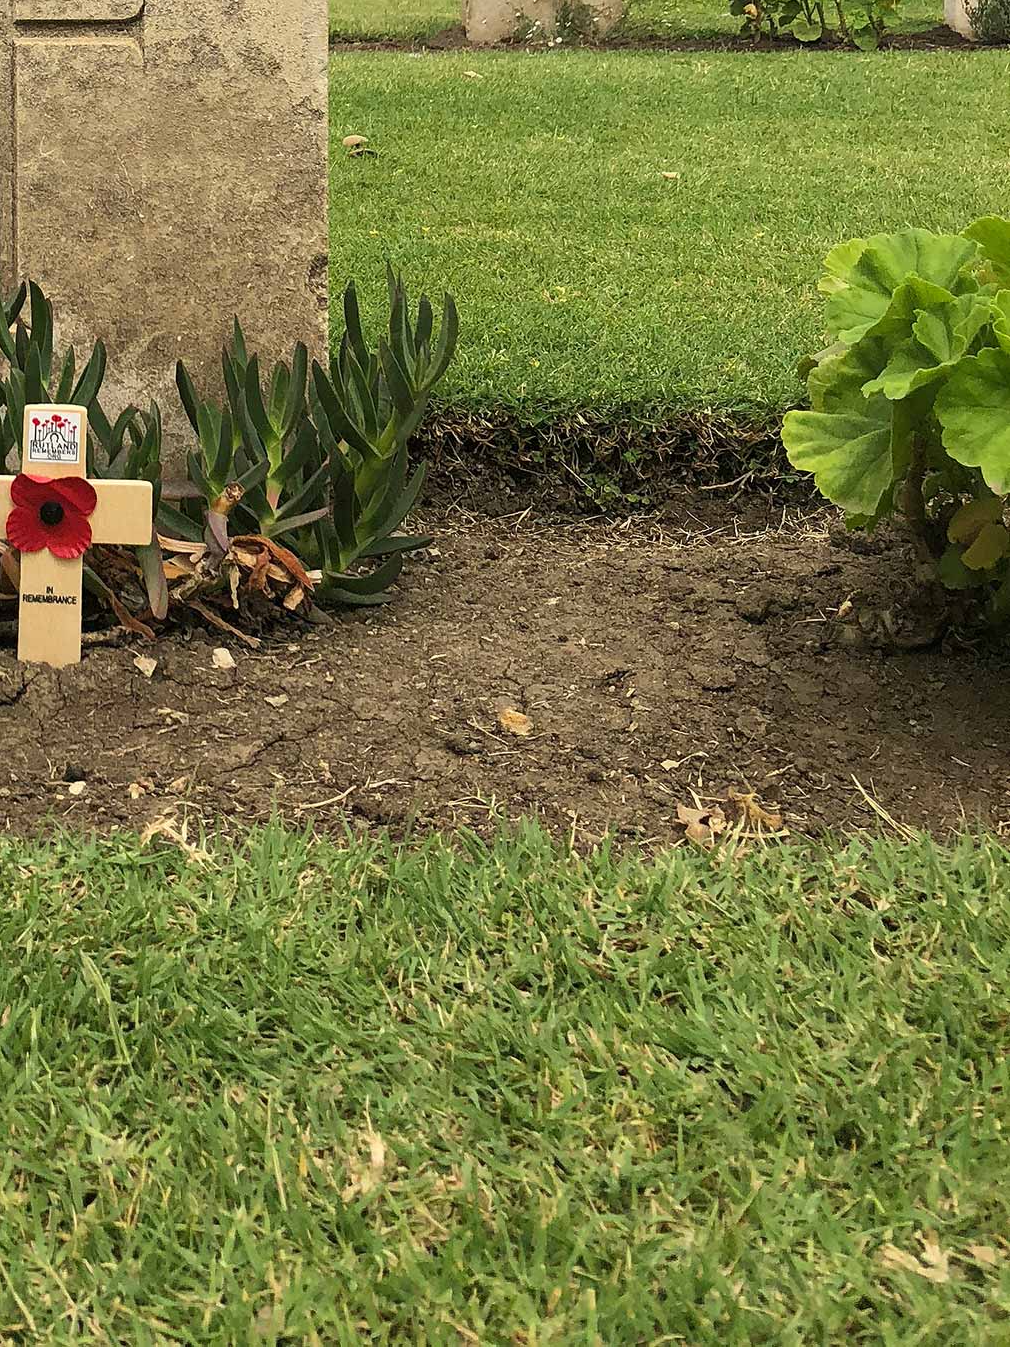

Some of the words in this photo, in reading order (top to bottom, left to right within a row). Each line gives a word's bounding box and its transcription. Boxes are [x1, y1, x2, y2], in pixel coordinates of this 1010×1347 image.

[32, 440, 77, 451] RUTLAND
[45, 585, 54, 595] IN
[22, 593, 78, 605] REMEMBRANCE
